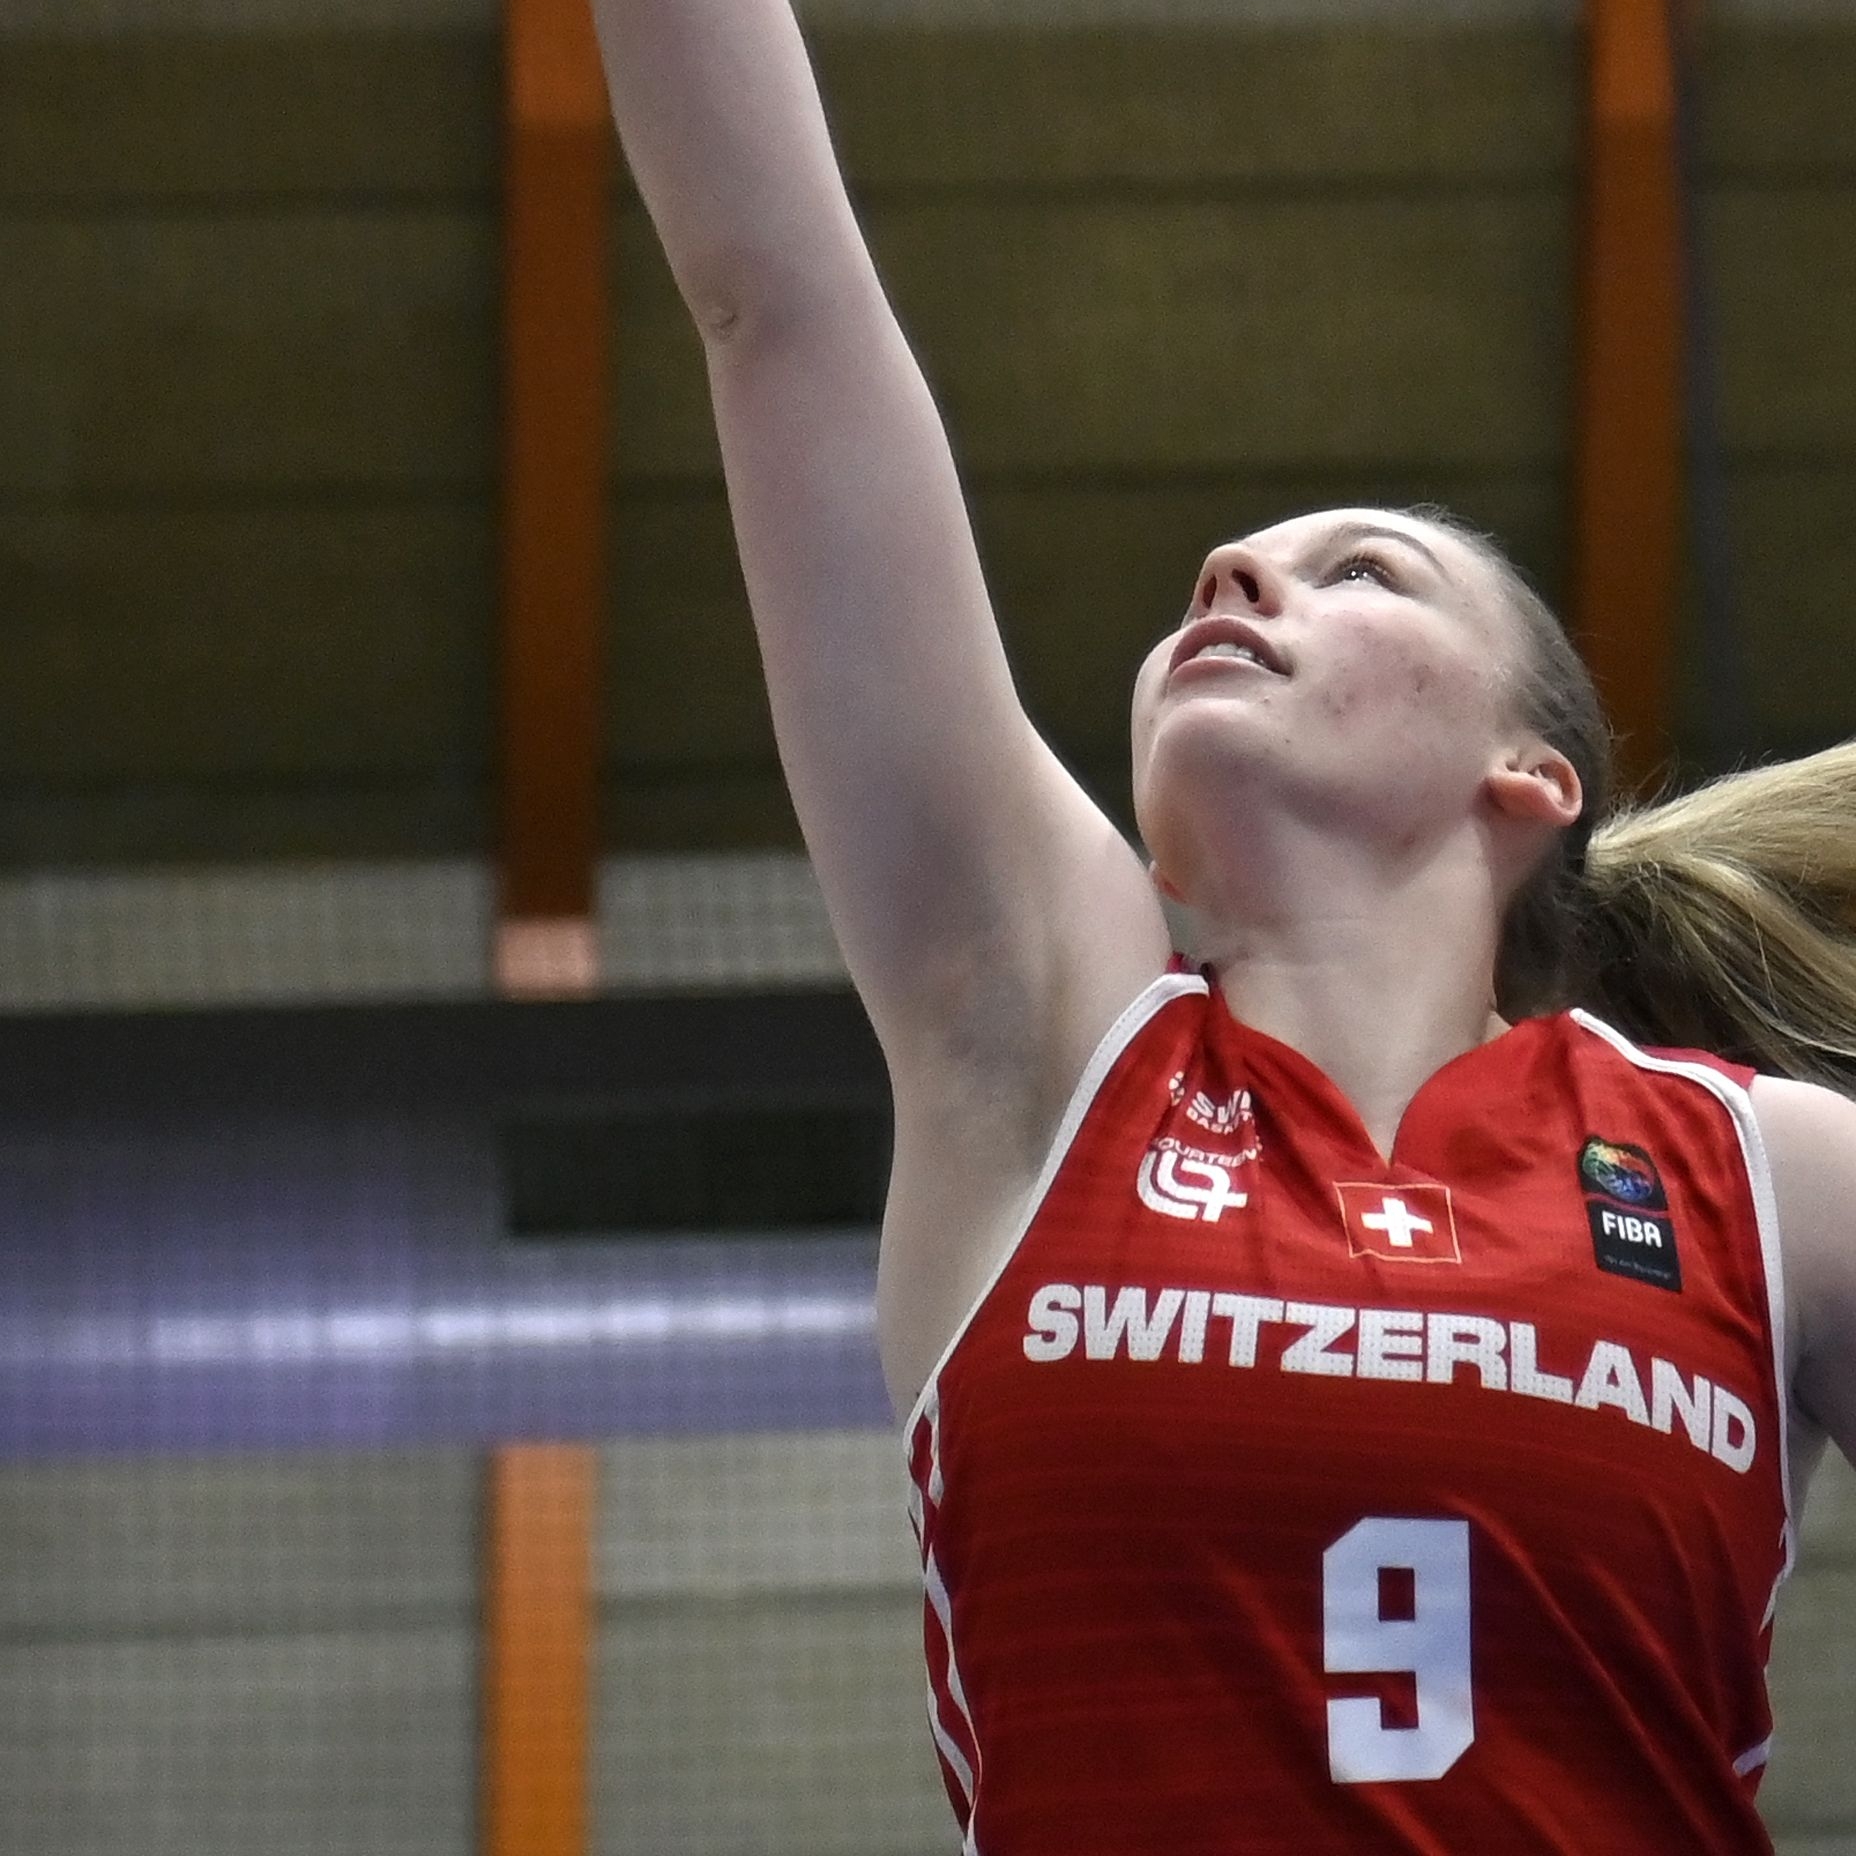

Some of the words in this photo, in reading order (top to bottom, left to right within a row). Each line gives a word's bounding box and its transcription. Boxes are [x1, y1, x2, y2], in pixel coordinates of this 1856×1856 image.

[1601, 1209, 1663, 1249] FIBA
[1022, 1282, 1758, 1475] SWITZERLAND
[1321, 1516, 1477, 1785] 9
